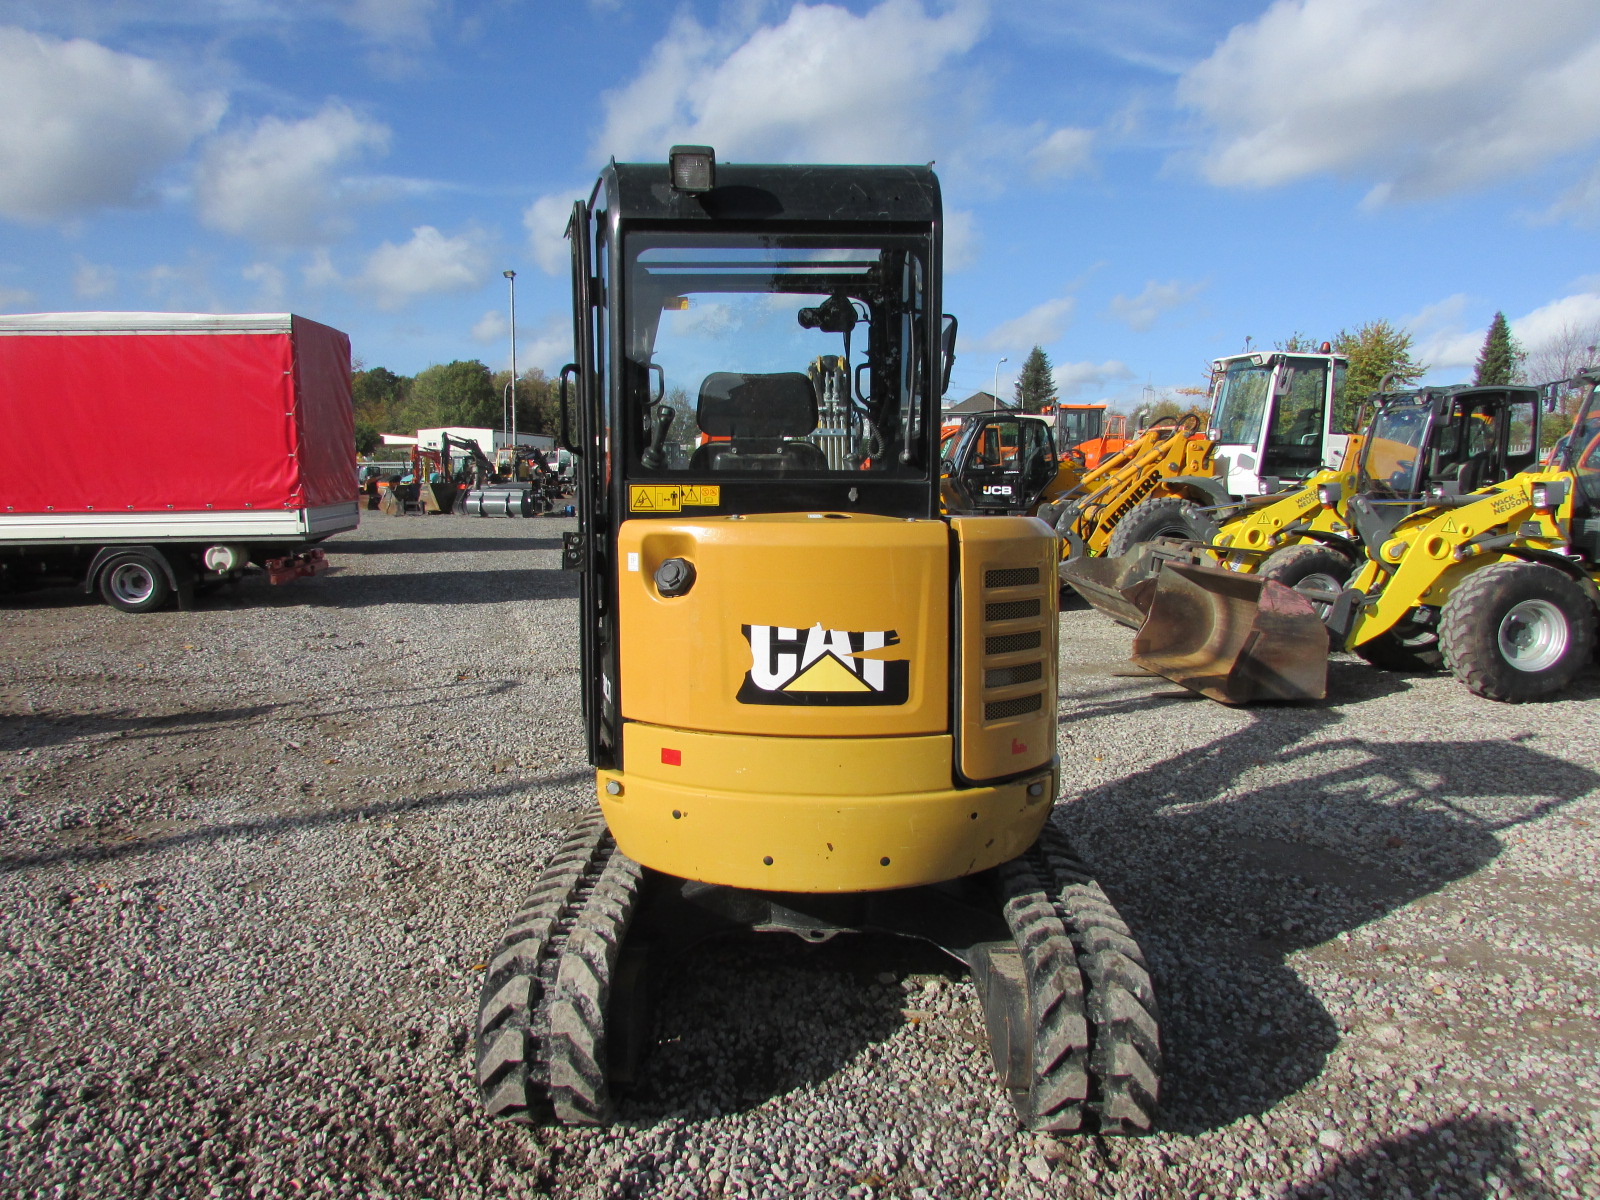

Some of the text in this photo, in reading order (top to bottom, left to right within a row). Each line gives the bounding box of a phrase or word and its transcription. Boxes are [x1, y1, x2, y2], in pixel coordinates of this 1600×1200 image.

[982, 485, 1012, 495] JCB
[1295, 489, 1318, 504] WACKE
[1100, 470, 1162, 534] LIEBHERR
[1298, 494, 1318, 509] NEUSO
